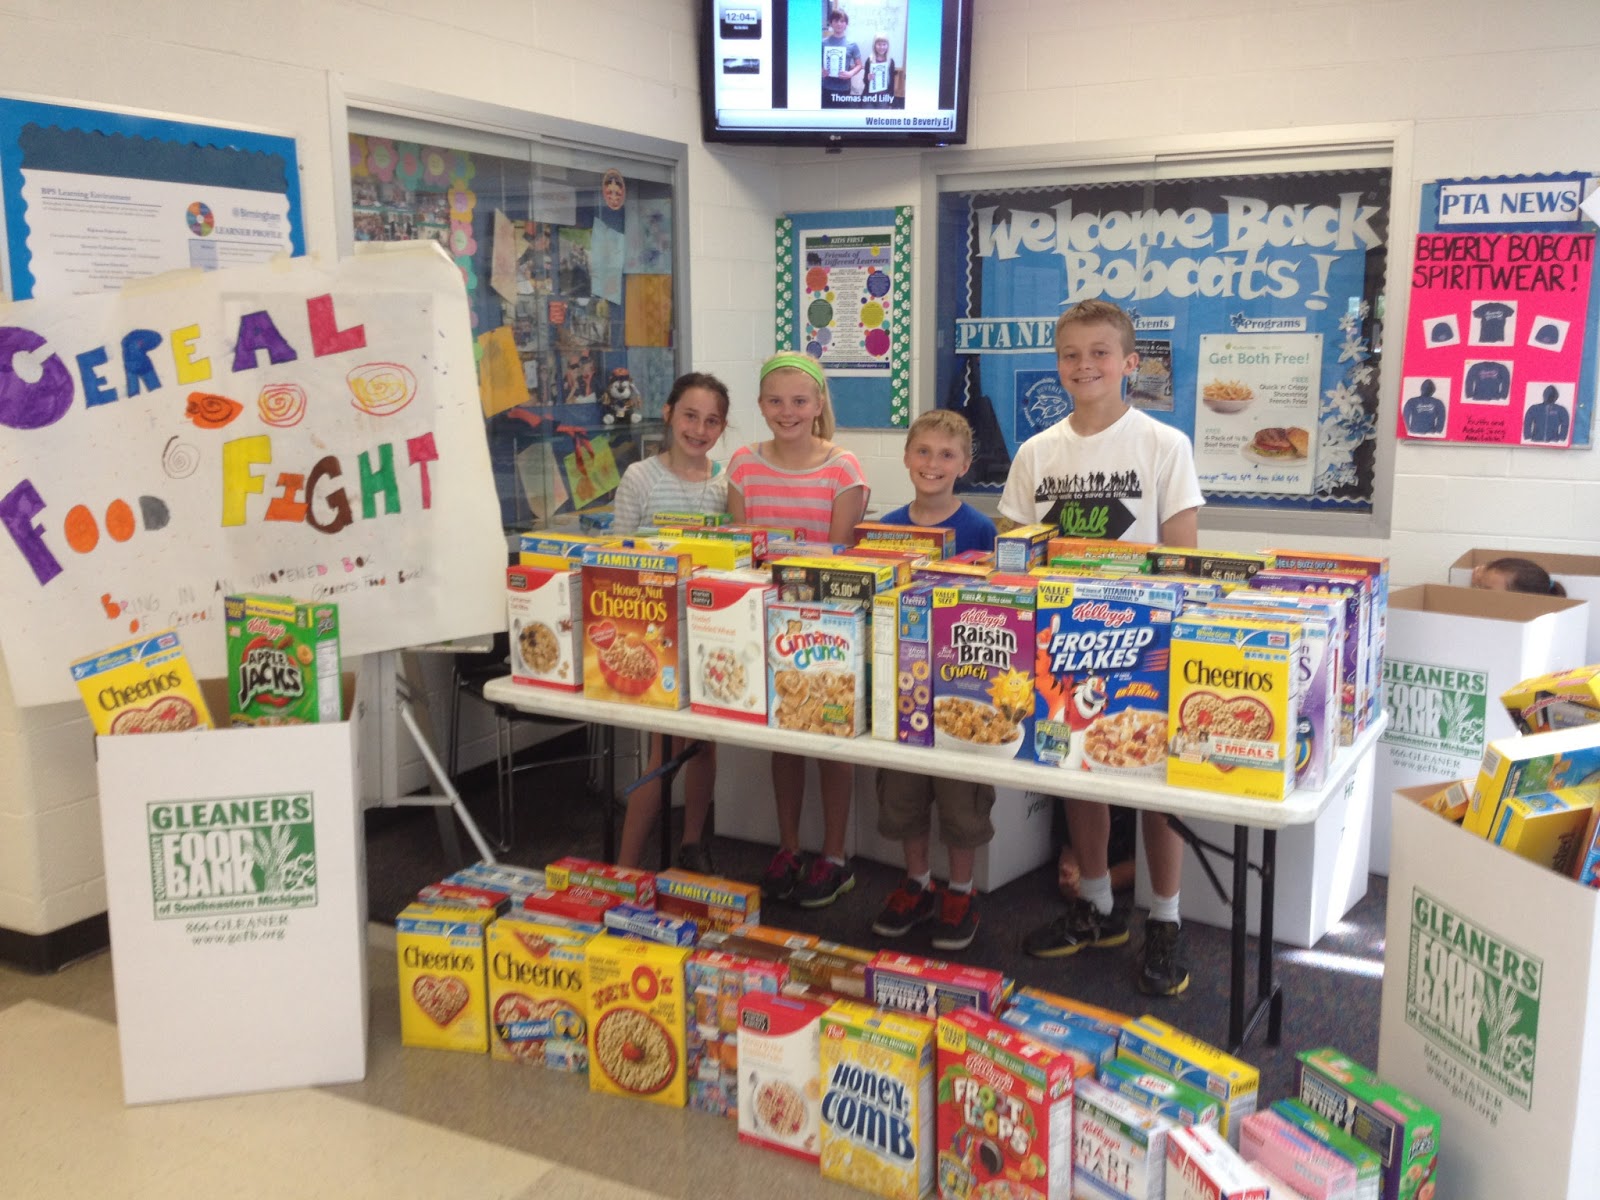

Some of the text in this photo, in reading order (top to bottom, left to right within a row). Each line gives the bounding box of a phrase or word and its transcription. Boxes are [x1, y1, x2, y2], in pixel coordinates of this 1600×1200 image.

[725, 12, 751, 22] 12:04
[831, 93, 894, 104] Thomas and Lilly
[865, 116, 901, 126] Welcome
[903, 117, 911, 126] to
[913, 117, 941, 127] Beverly
[58, 188, 88, 199] Learning
[90, 190, 131, 200] Environment
[1441, 190, 1578, 216] PTA NEWS
[215, 226, 282, 239] LEARNER PROFILE
[974, 191, 1386, 260] Welcome Back
[824, 250, 859, 260] Friends of
[1415, 235, 1595, 263] BEVERLY BOBCAT
[824, 259, 855, 267] Different
[959, 322, 1012, 348] PTA
[1135, 319, 1169, 329] Events
[1243, 319, 1300, 330] Programs
[0, 293, 367, 431] CEREAL
[1209, 352, 1310, 365] Get Both Free!
[1273, 391, 1308, 399] Shoestring
[1287, 384, 1309, 393] Crispy
[0, 432, 440, 586] FOOD FIGHT
[1084, 492, 1104, 500] save
[1059, 504, 1110, 537] Walk
[596, 552, 665, 570] FAMILY SIZE
[1276, 560, 1295, 569] HELP
[612, 582, 664, 601] Honey Nut
[830, 582, 853, 598] $5.00
[902, 595, 927, 606] Cheerios
[935, 590, 956, 598] VALUE
[1040, 584, 1071, 595] VALUE
[1043, 594, 1065, 603] SIZE
[1103, 587, 1136, 597] VITAMIN
[590, 589, 668, 622] Cheerios
[960, 607, 1008, 628] Kellogg's
[1072, 601, 1136, 628] Kellogg's
[247, 617, 286, 639] Kellogg's
[952, 623, 1017, 653] Raisin
[1049, 626, 1155, 654] FROSTED
[775, 629, 850, 657] Cinnamon
[248, 649, 289, 666] APPLE
[793, 644, 845, 670] Crunch
[959, 645, 1009, 670] Bran
[1051, 647, 1140, 673] FLAKES
[940, 663, 988, 682] Crunch
[1183, 658, 1274, 692] Cheerios
[1383, 662, 1485, 694] GLEANERS
[97, 668, 182, 712] Cheerios
[238, 663, 304, 710] JACKS
[1216, 743, 1222, 753] 5
[1225, 744, 1275, 760] MEALS
[1383, 733, 1438, 751] Southeastern
[1439, 742, 1481, 757] Michigan
[151, 796, 310, 830] GLEANERS
[162, 829, 254, 867] FOOD
[164, 858, 258, 899] BANK
[158, 894, 314, 914] of Southeastern Michigan
[668, 881, 735, 907] FAMILY SIZE
[403, 944, 475, 972] Cheerios
[1414, 896, 1538, 994] GLEANERS
[493, 950, 583, 993] Cheerios
[1417, 930, 1487, 1000] FOOD
[1414, 974, 1484, 1054] BANK
[825, 1024, 845, 1039] Post
[1419, 1013, 1477, 1067] Southeastern
[1479, 1058, 1529, 1101] Michigan
[965, 1052, 1015, 1093] Kellogg's
[953, 1077, 1024, 1128] FROOT
[962, 1101, 1030, 1155] LOOPS
[1081, 1119, 1121, 1150] Kellogg's
[1075, 1152, 1133, 1195] TART
